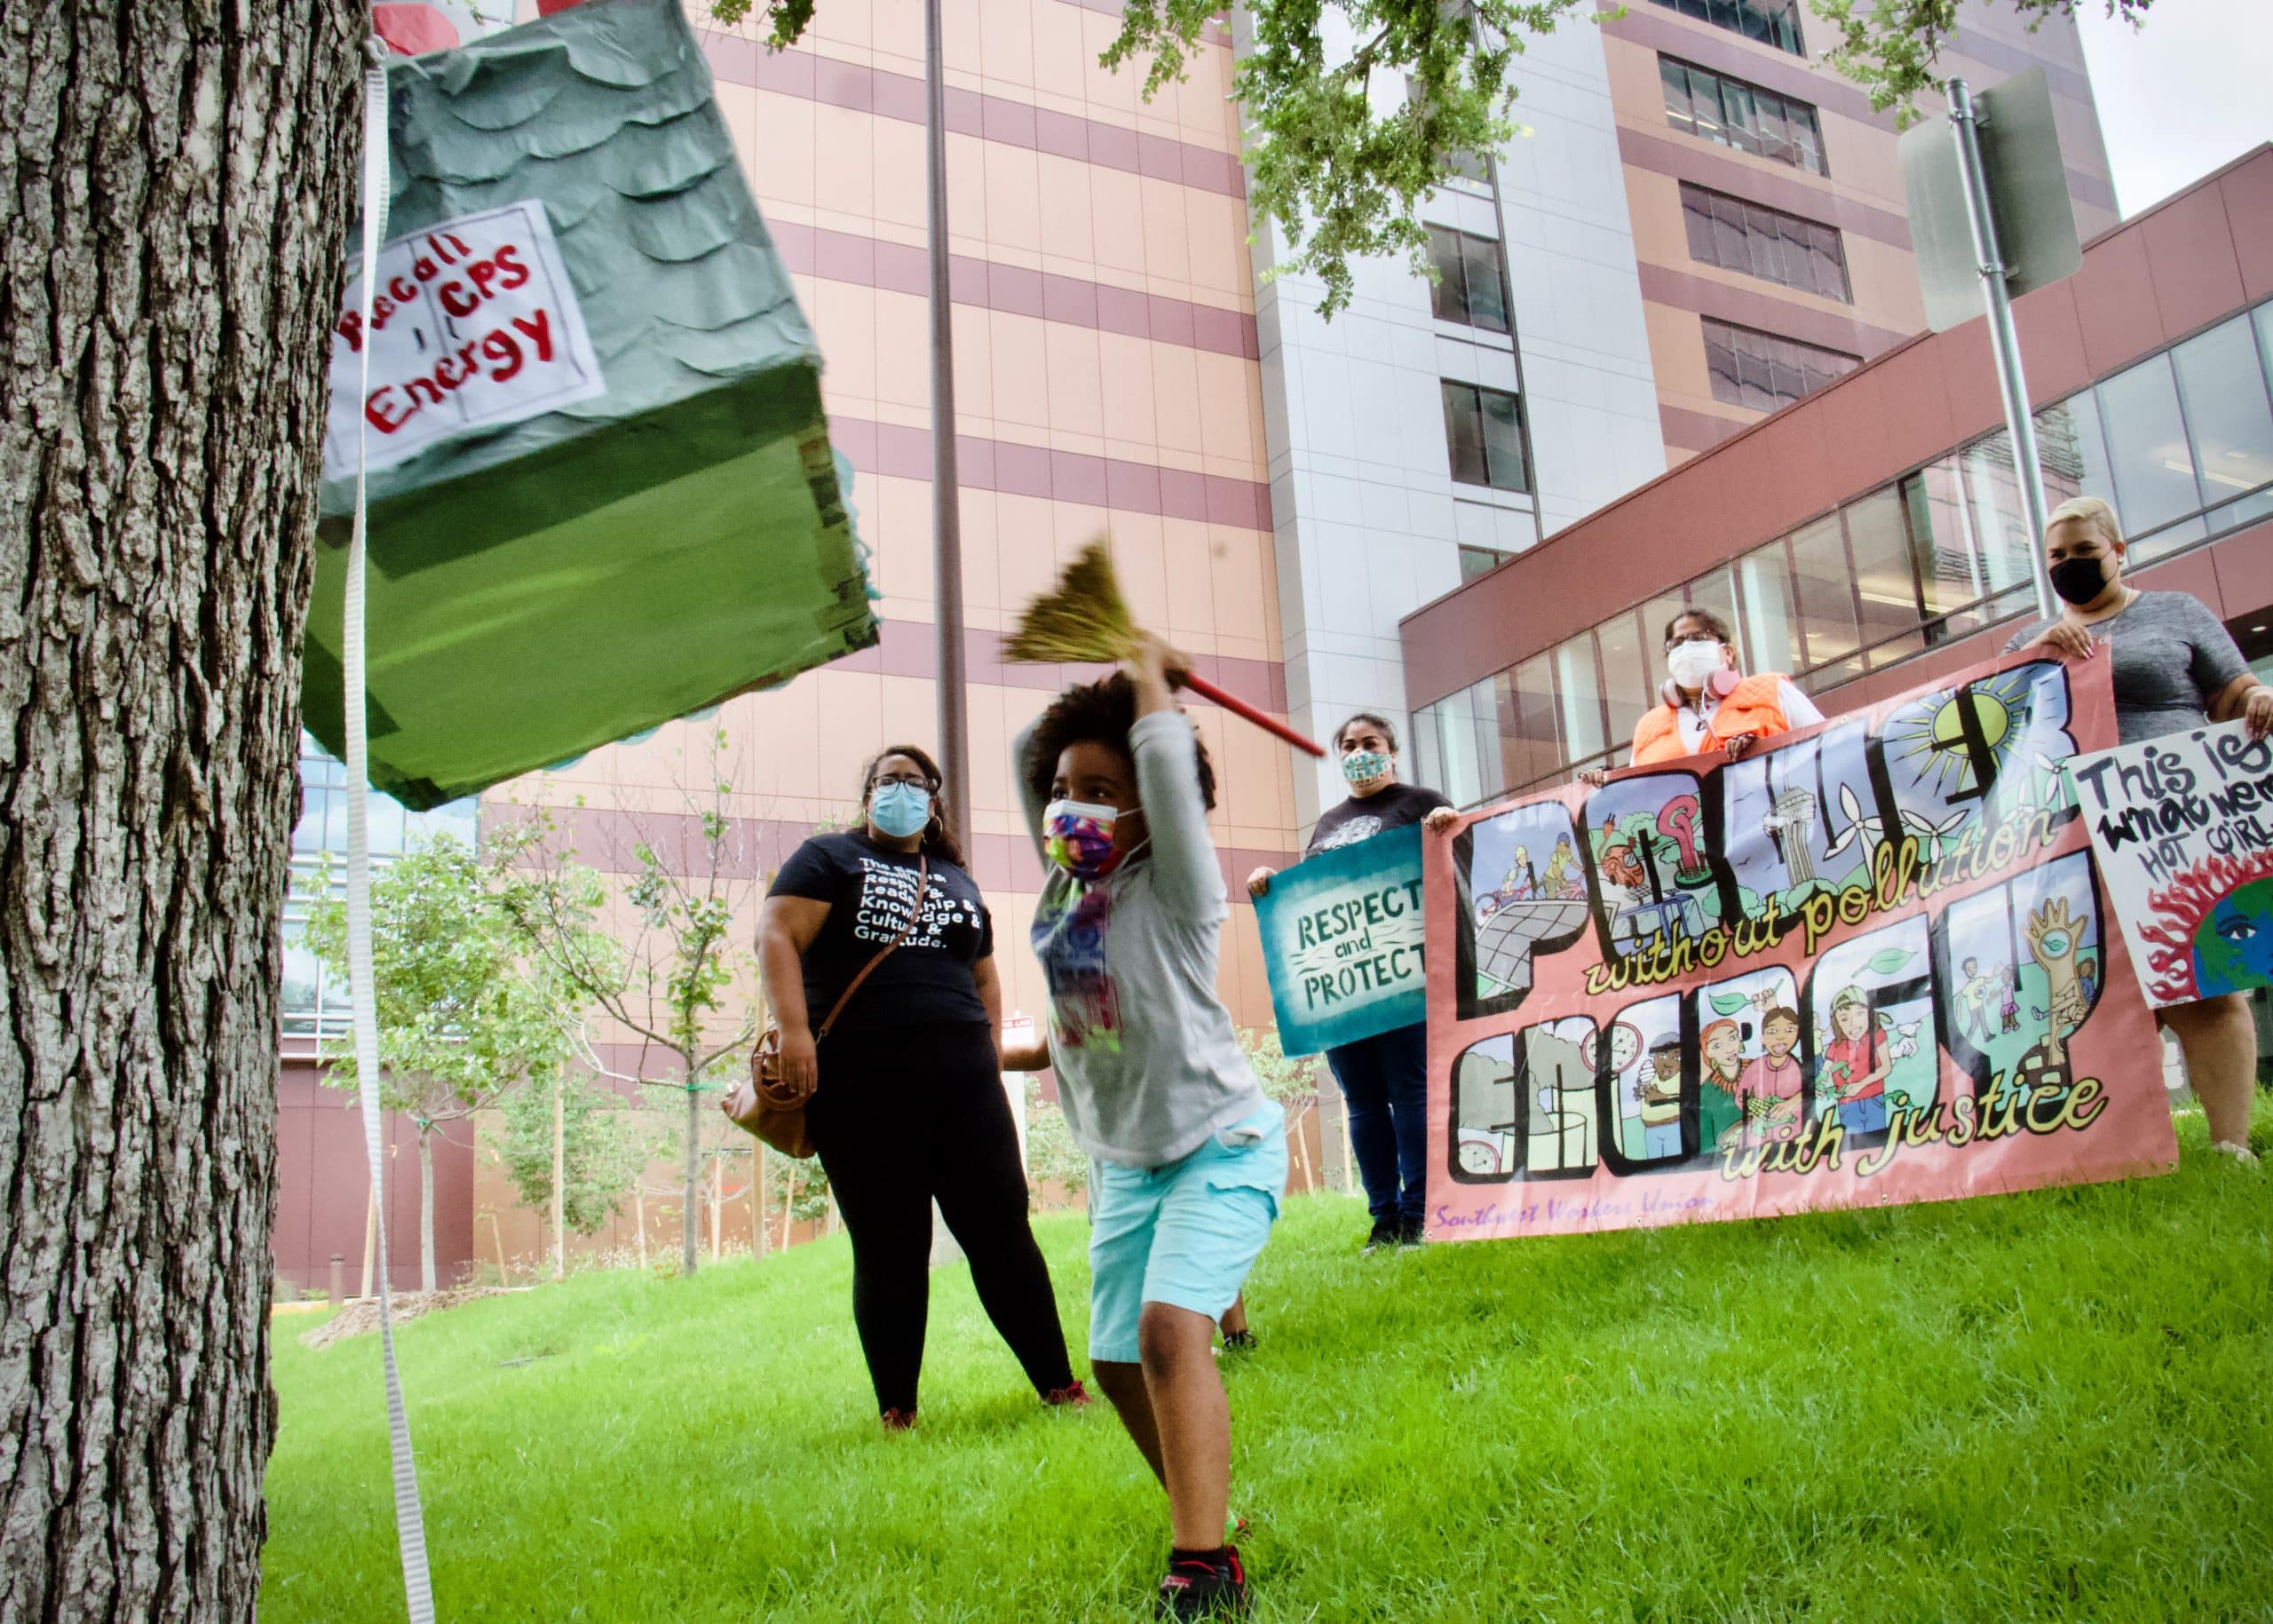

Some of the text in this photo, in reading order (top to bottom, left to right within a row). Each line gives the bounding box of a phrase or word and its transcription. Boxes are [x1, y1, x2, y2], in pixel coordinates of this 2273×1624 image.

[337, 233, 472, 353] Recall
[439, 244, 530, 318] CPS
[365, 308, 554, 435] Energy
[2075, 746, 2196, 810] This
[2191, 731, 2273, 780] is
[2096, 793, 2211, 853] what
[2137, 832, 2190, 883] HOT
[857, 910, 942, 935] Cultue &
[1297, 877, 1424, 950] RESPECT
[1583, 809, 2059, 995] without pollution
[1334, 927, 1373, 959] and
[1722, 1069, 2109, 1182] with justice
[1435, 1188, 1714, 1228] Southwest Workers Union
